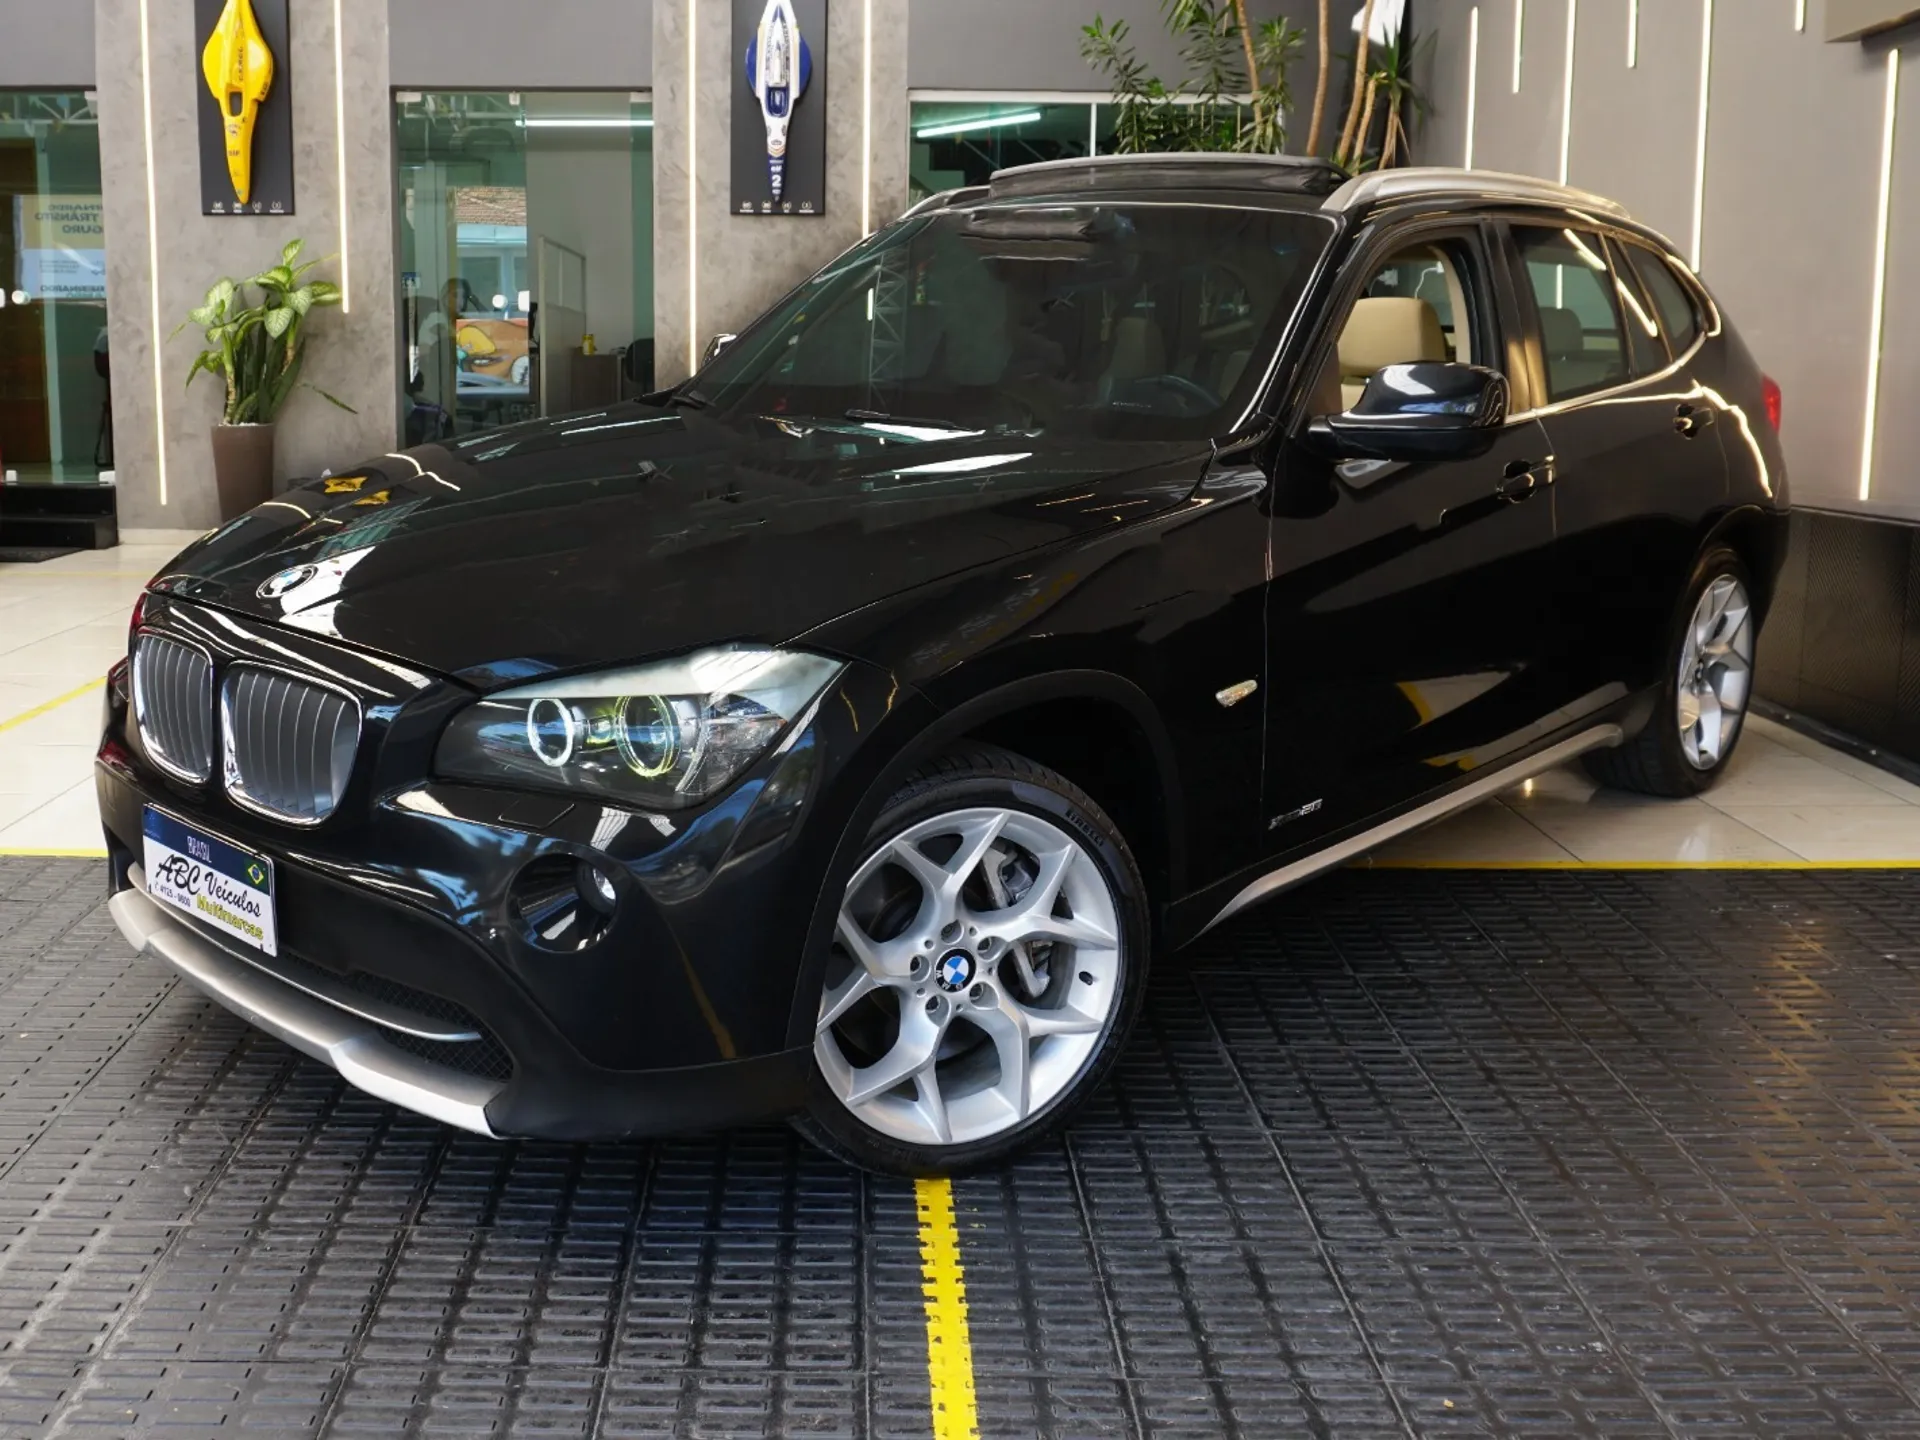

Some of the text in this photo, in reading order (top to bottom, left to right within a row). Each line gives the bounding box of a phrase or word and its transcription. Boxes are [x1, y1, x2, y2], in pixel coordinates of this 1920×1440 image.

[772, 174, 782, 188] 2
[186, 836, 212, 863] BRASIL
[155, 854, 200, 895] ABC
[196, 893, 264, 940] Multimarcas
